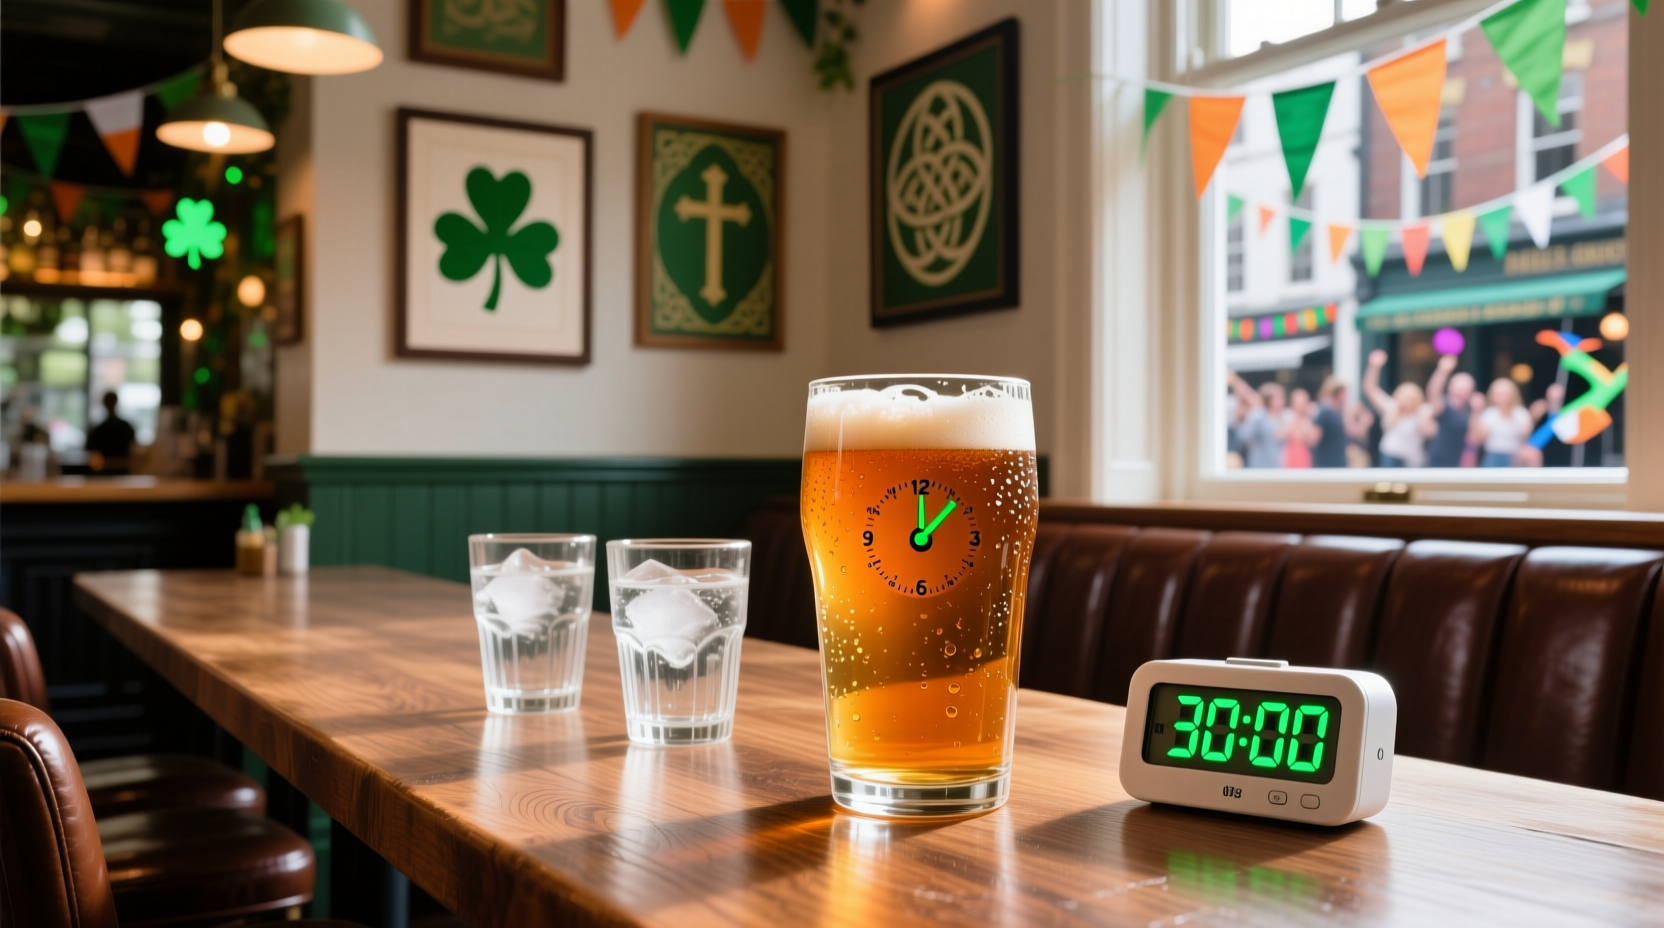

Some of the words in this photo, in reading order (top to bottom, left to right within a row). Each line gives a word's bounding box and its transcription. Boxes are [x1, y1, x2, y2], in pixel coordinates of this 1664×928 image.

[911, 479, 930, 495] 12
[862, 530, 874, 546] 9
[969, 530, 981, 546] 3
[916, 579, 927, 596] 6
[1167, 695, 1329, 772] 30:00
